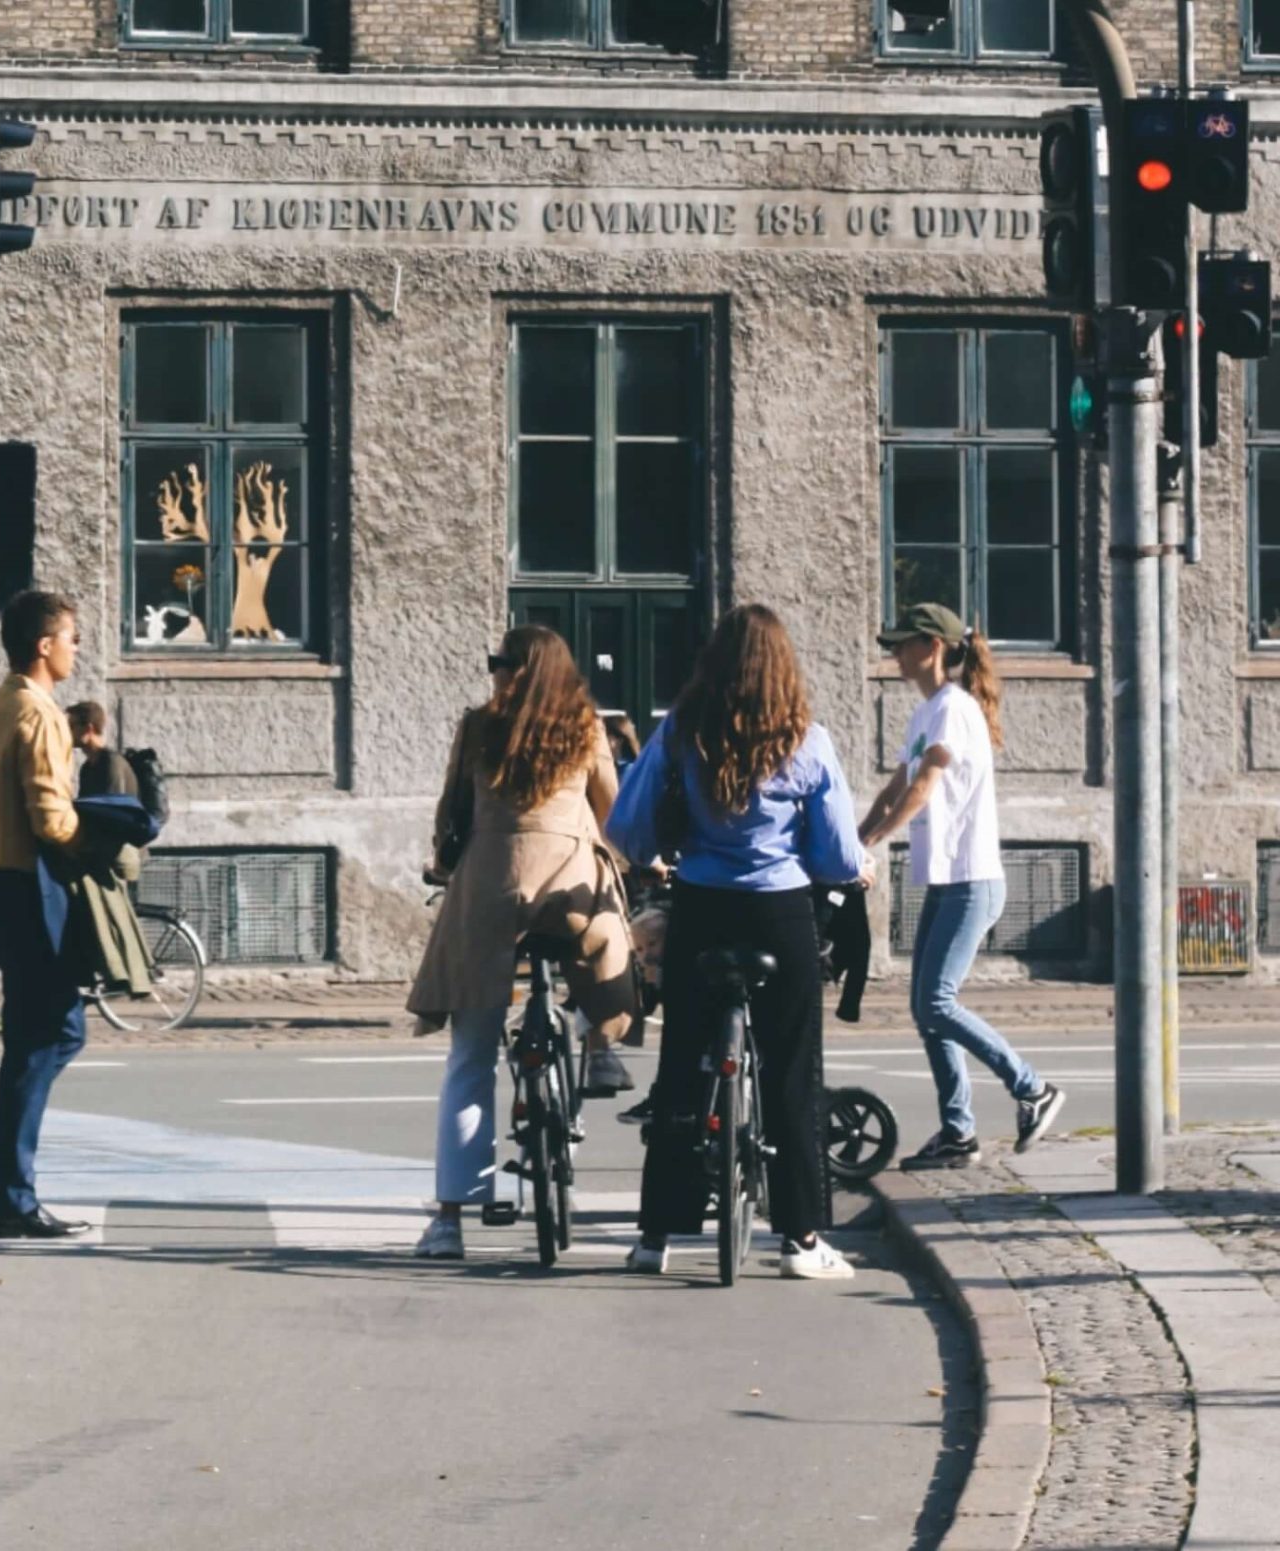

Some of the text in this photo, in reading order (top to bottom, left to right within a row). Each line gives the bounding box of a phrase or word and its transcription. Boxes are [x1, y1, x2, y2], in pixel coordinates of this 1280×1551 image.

[154, 196, 211, 230] AF
[756, 203, 827, 236] 1851
[846, 204, 893, 237] OG
